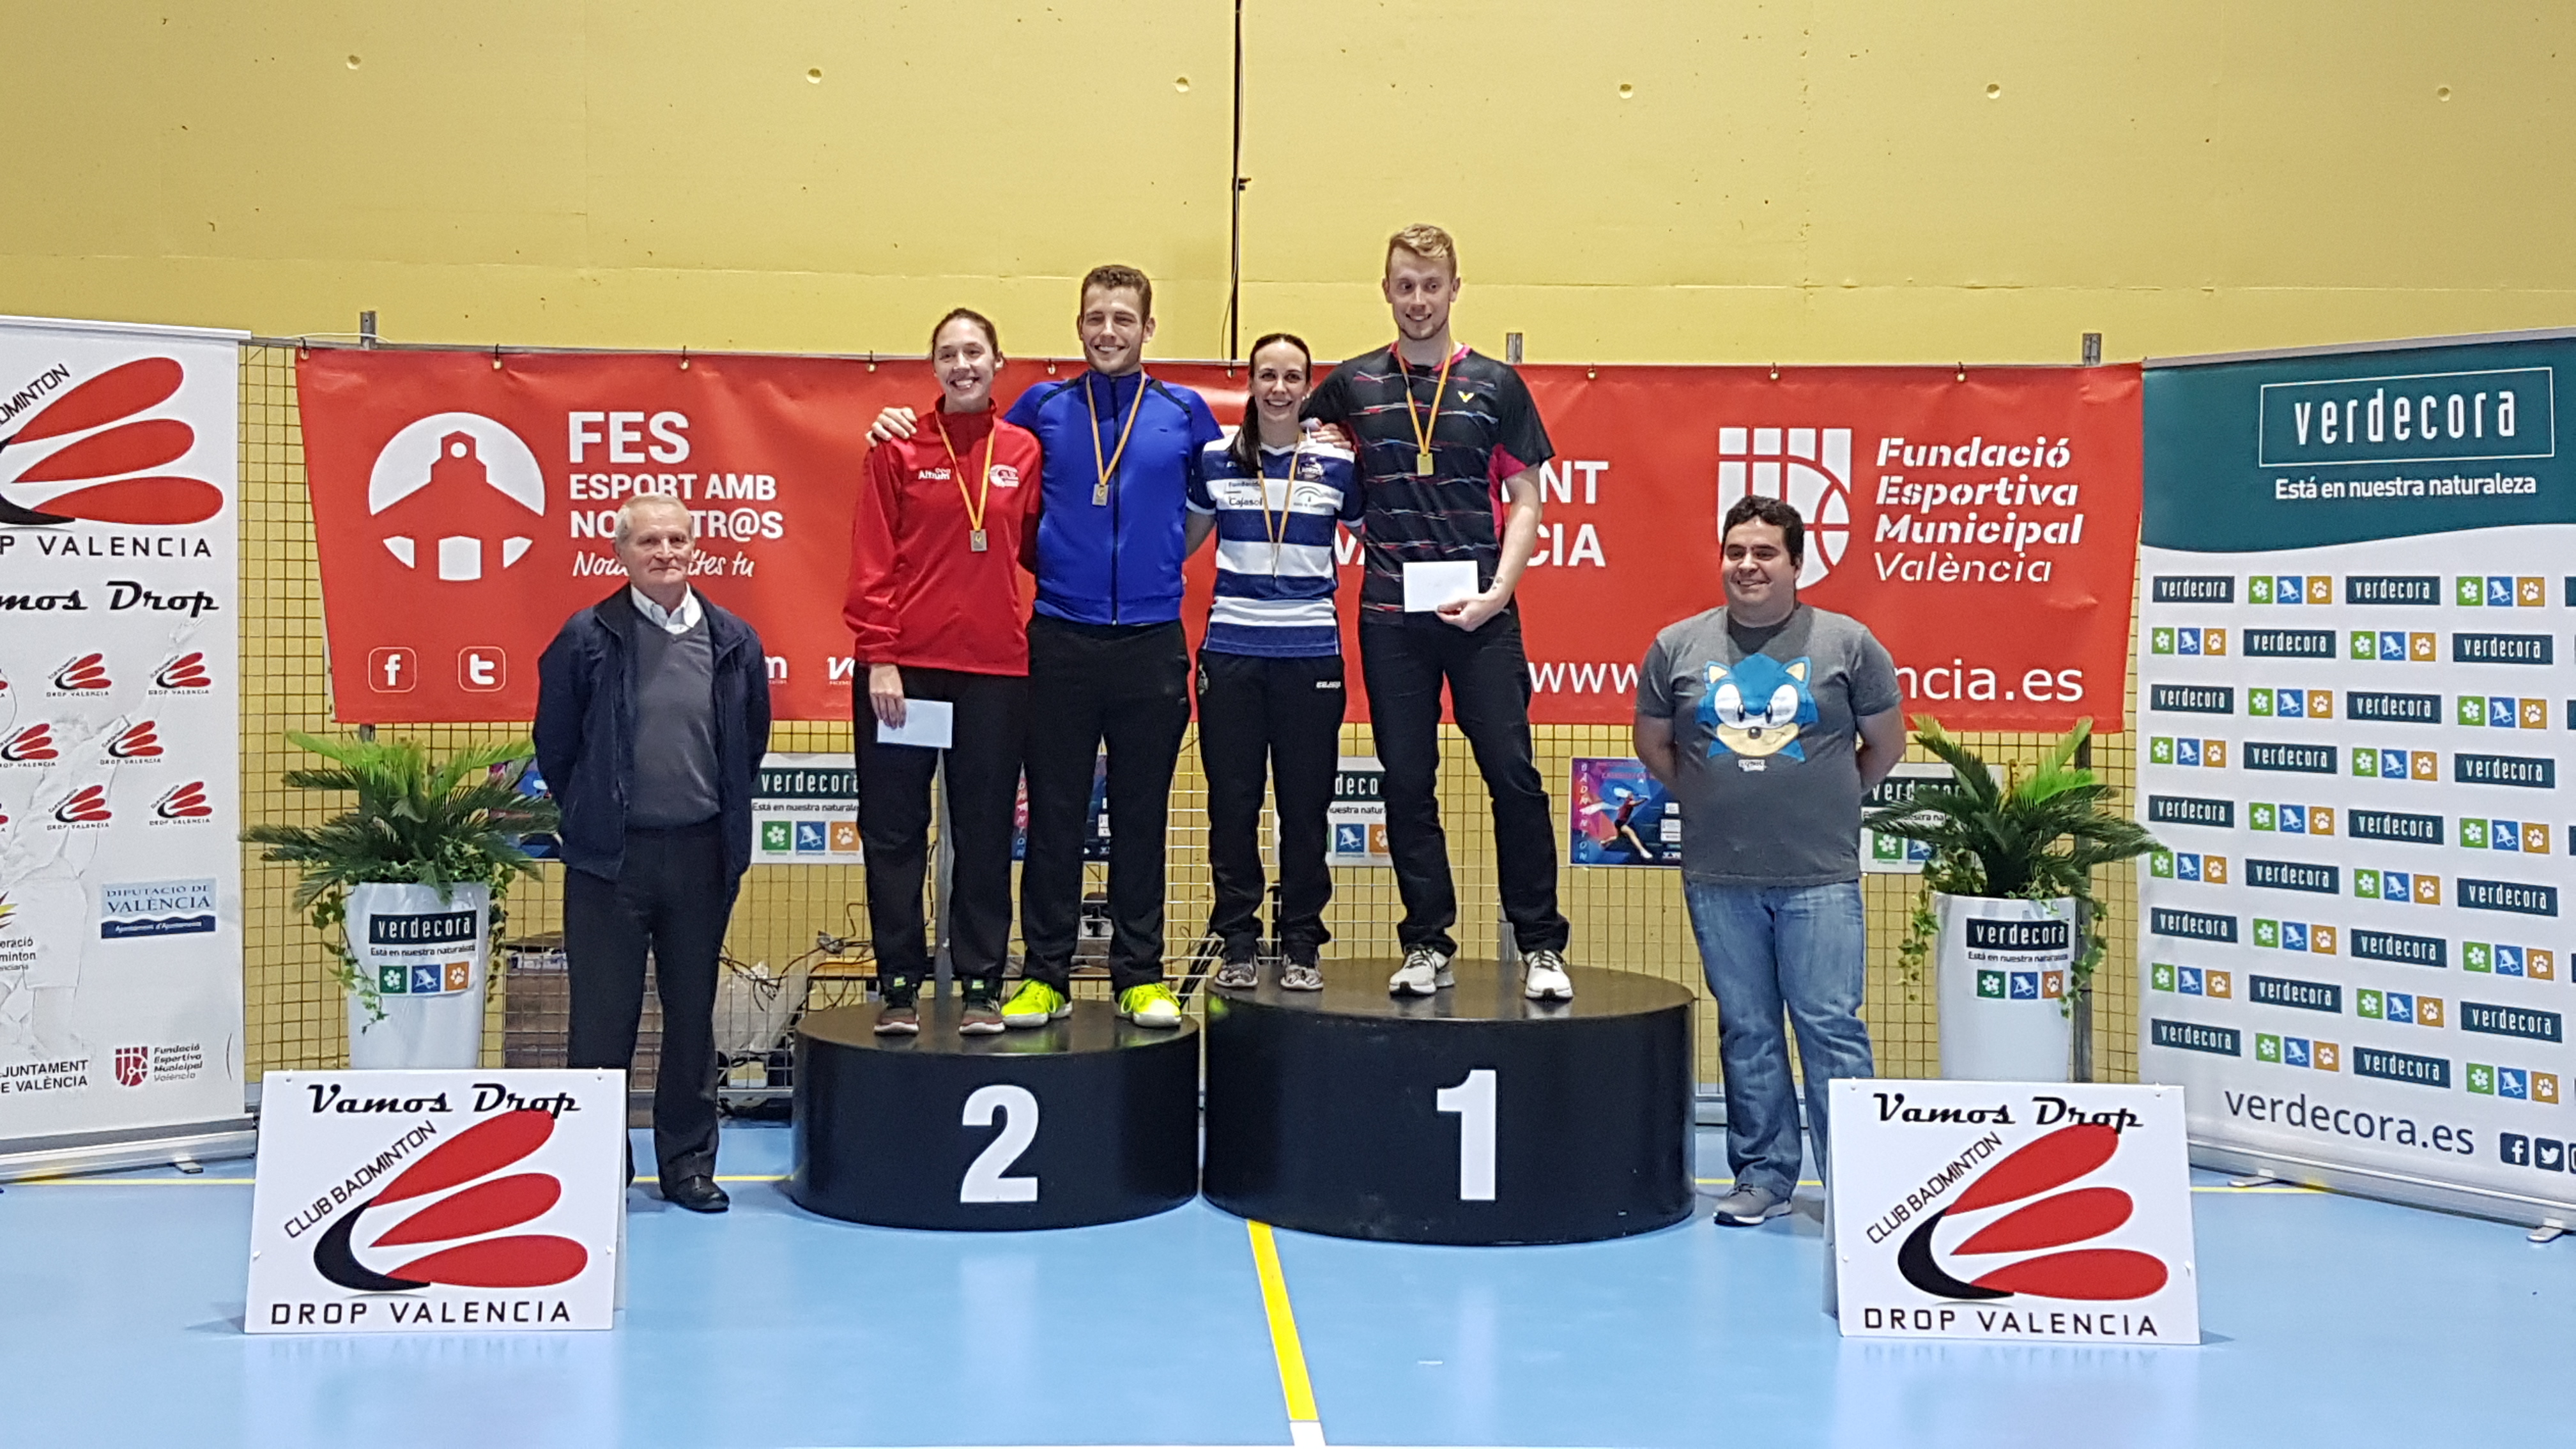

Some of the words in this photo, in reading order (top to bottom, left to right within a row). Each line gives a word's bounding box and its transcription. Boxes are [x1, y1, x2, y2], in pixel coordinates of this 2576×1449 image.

[0, 364, 70, 426] DMINTON
[2295, 388, 2515, 446] verdecora
[569, 411, 690, 464] FES
[1876, 436, 2071, 468] Fundació
[570, 473, 698, 500] ESPORT
[705, 473, 777, 501] AMB
[1876, 474, 2079, 514] Esportiva
[2276, 477, 2317, 500] Está
[2322, 480, 2345, 498] en
[2350, 477, 2424, 498] nuestra
[2429, 473, 2536, 496] naturaleza
[571, 508, 783, 542] NOTR@S
[1874, 512, 2084, 552] Municipal
[37, 535, 212, 558] VALENCIA
[732, 551, 755, 578] tu
[1874, 551, 2052, 582] València
[0, 590, 89, 611] mos
[105, 581, 220, 618] Drop
[2161, 578, 2227, 598] verdecora
[2355, 578, 2430, 599] verdecora
[2253, 631, 2327, 652] verdecora
[2464, 636, 2542, 659] verdecora
[1894, 659, 2083, 702] ncia.es
[2159, 687, 2226, 709] verdecora
[2356, 694, 2432, 717] verdecora
[2253, 745, 2328, 768] verdecora
[2465, 758, 2543, 782] verdecora
[786, 803, 820, 811] nuestra
[2158, 799, 2226, 822] verdecora
[2358, 814, 2434, 838] verdecora
[2256, 864, 2330, 888] verdecora
[2468, 884, 2547, 910] verdecora
[378, 917, 471, 939] verdecora
[1977, 923, 2065, 944] verdecora
[2159, 912, 2228, 937] verdecora
[371, 947, 388, 956] Está
[2361, 935, 2437, 961] verdecora
[2259, 981, 2333, 1006] verdecora
[2472, 1008, 2552, 1036] verdecora
[2161, 1024, 2232, 1050] verdecora
[0, 1059, 89, 1078] JUNTAMENT
[2363, 1053, 2440, 1081] verdecora
[0, 1082, 10, 1093] E
[16, 1075, 88, 1092] VALÈNCIA
[307, 1084, 454, 1114] Vamos
[471, 1083, 582, 1120] Drop
[1873, 1093, 2016, 1124] Vamos
[2032, 1096, 2144, 1135] Drop
[1437, 1069, 1497, 1201] 1
[2225, 1091, 2475, 1155] verdecora.es
[960, 1084, 1039, 1203] 2
[284, 1197, 333, 1239] CLUB
[330, 1119, 437, 1205] BADMINTON
[1866, 1204, 1912, 1245] CLUB
[1907, 1131, 2003, 1211] BADMINTON
[271, 1303, 367, 1324] DROP
[390, 1301, 570, 1323] VALENCIA
[1865, 1308, 1956, 1331] DROP
[1977, 1310, 2158, 1337] VALENCIA
